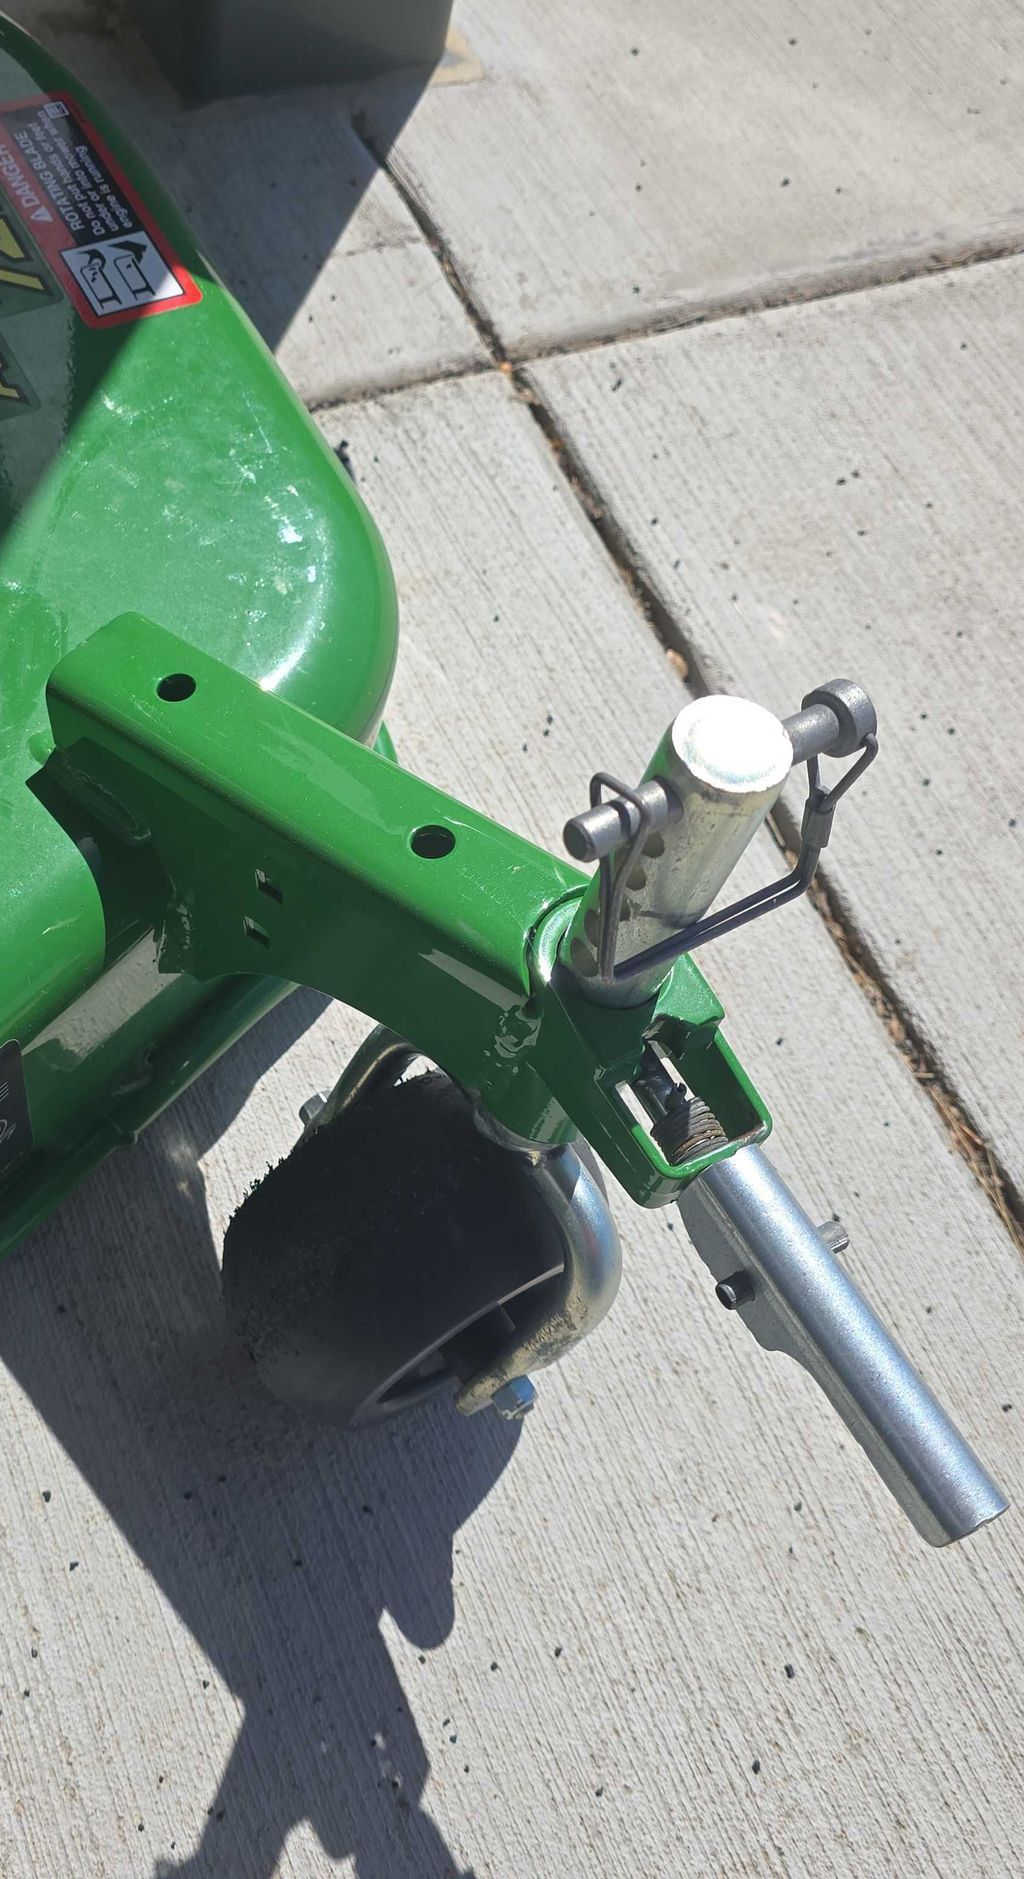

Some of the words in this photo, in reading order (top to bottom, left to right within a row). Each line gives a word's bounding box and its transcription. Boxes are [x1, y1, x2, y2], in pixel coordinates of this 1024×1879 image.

[14, 131, 47, 170] BLADE
[41, 141, 54, 153] or
[53, 137, 78, 169] mower
[49, 153, 72, 184] hands
[76, 145, 104, 183] running
[75, 170, 92, 189] into
[99, 183, 111, 195] is
[40, 171, 85, 232] ROTATING
[67, 184, 86, 203] put
[87, 190, 100, 202] or
[78, 201, 95, 219] not
[96, 203, 119, 232] under
[107, 194, 133, 230] engine
[91, 219, 106, 237] Do
